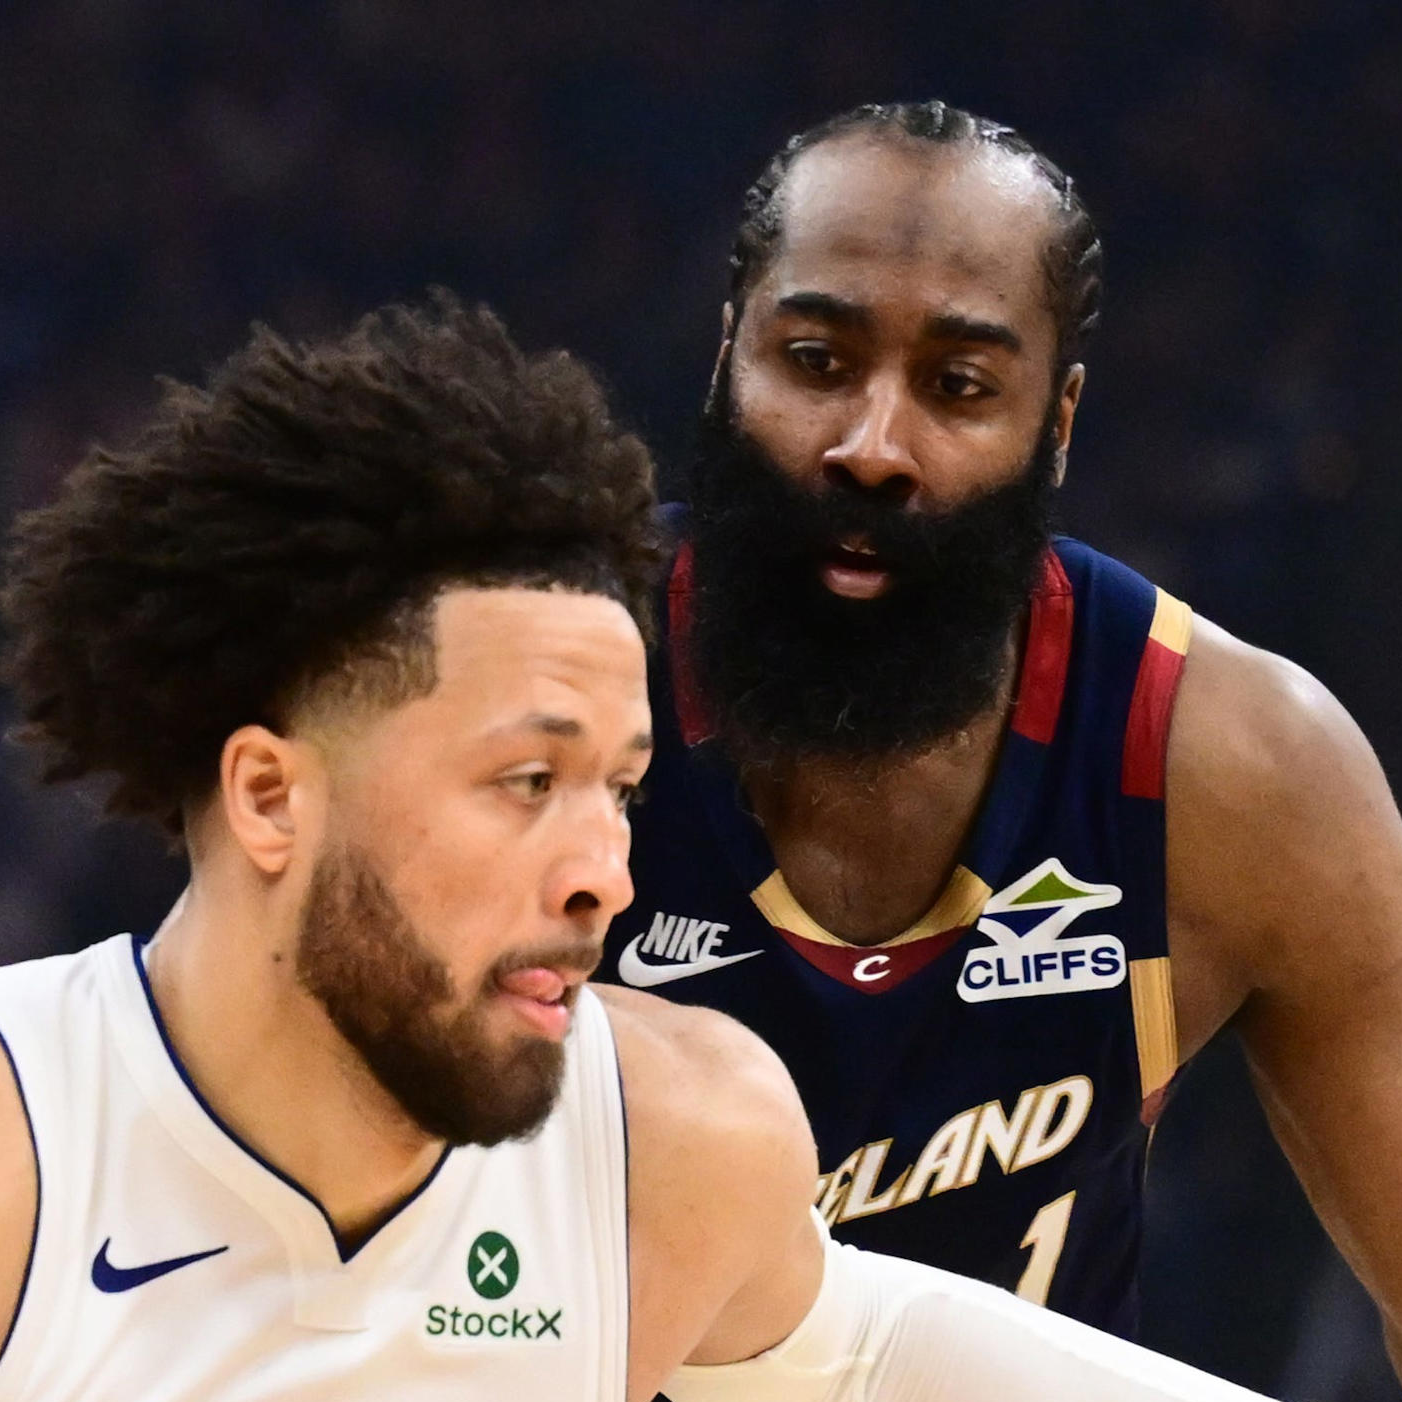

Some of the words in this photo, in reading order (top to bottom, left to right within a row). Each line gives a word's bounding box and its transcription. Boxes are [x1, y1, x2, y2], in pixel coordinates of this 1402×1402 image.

[640, 910, 731, 964] NIKE
[852, 954, 892, 983] C
[963, 945, 1122, 990] CLIFFS
[815, 1074, 1095, 1228] ELAND
[1015, 1189, 1077, 1308] 1
[425, 1304, 563, 1340] StockX
